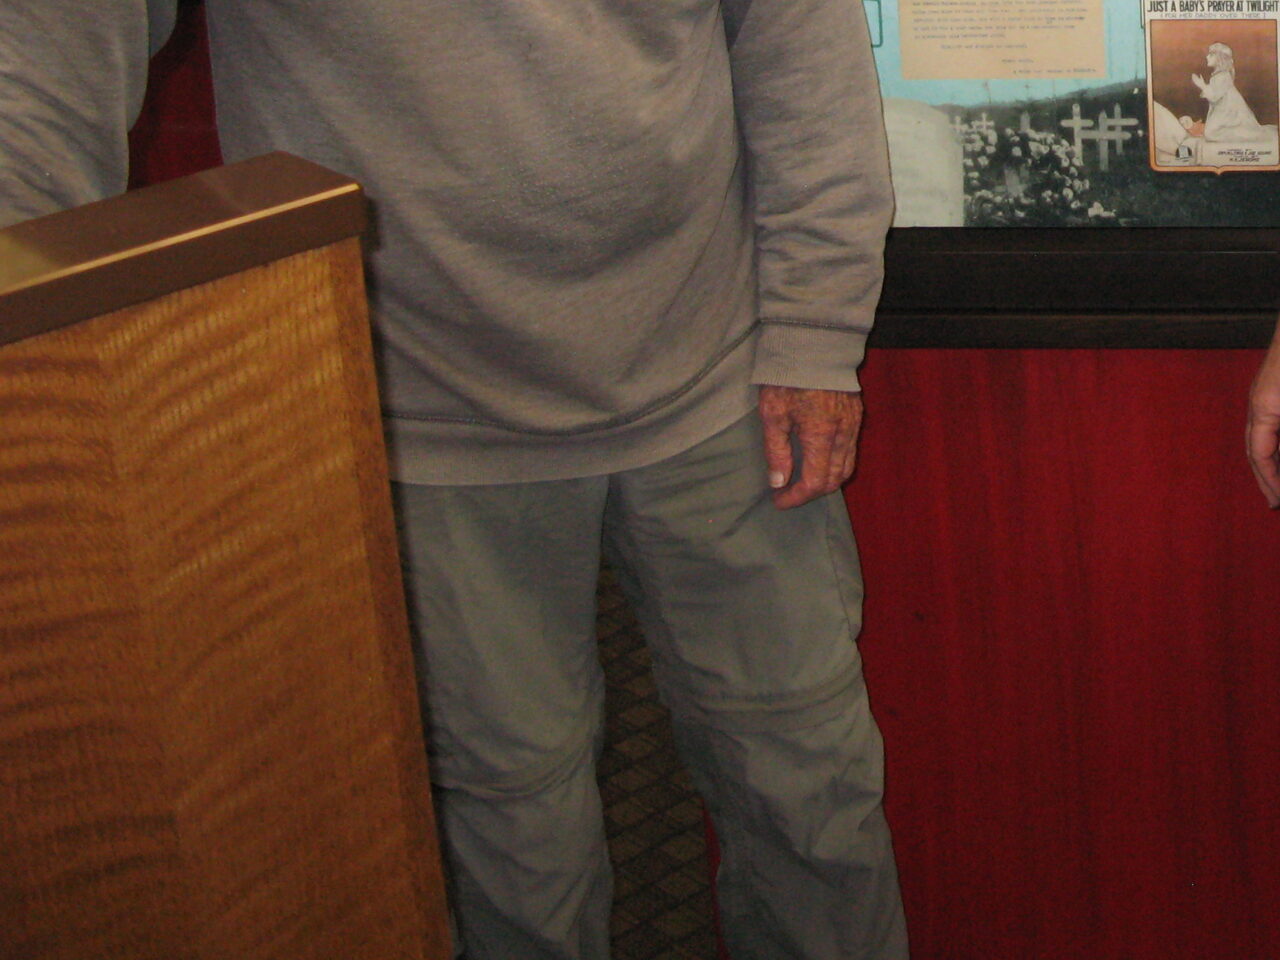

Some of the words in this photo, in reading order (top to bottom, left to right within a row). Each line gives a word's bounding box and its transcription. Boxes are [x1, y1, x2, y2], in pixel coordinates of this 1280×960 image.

[1147, 1, 1168, 12] JUST
[1171, 1, 1177, 12] A
[1180, 1, 1204, 12] BABY'S
[1208, 1, 1234, 12] PRAYER
[1236, 0, 1244, 11] AT
[1247, 0, 1280, 12] TWILIGHT
